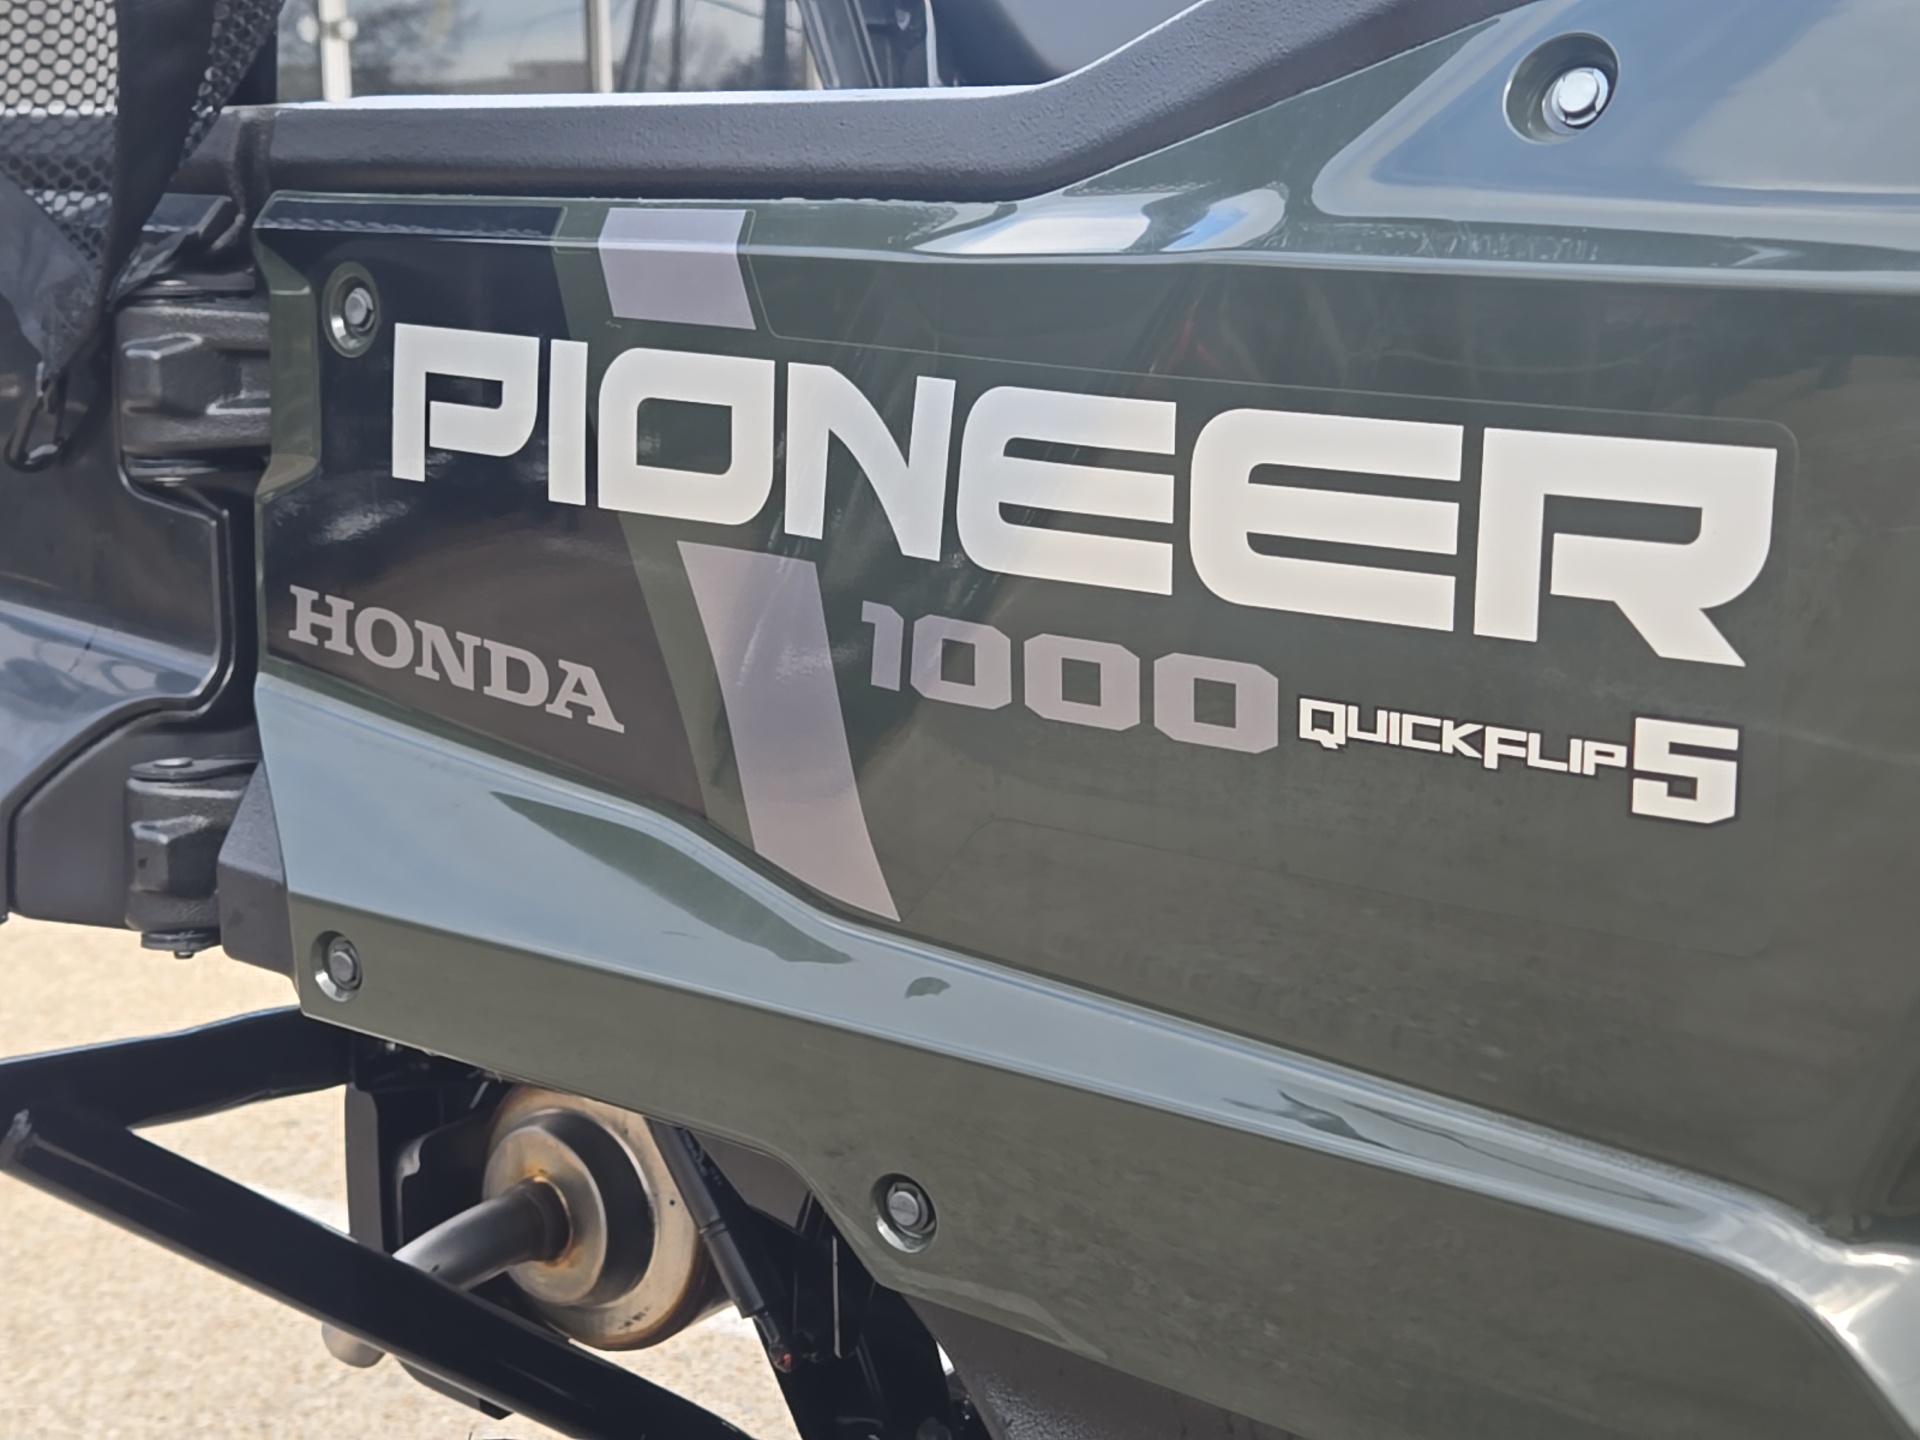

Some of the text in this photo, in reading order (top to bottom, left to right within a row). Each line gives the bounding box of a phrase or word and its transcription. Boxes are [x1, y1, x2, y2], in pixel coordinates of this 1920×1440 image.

[391, 322, 1778, 668] PIONEER
[287, 584, 626, 734] HONDA
[861, 600, 1280, 755] 1000
[1298, 696, 1740, 825] QUICKFLIP 5
